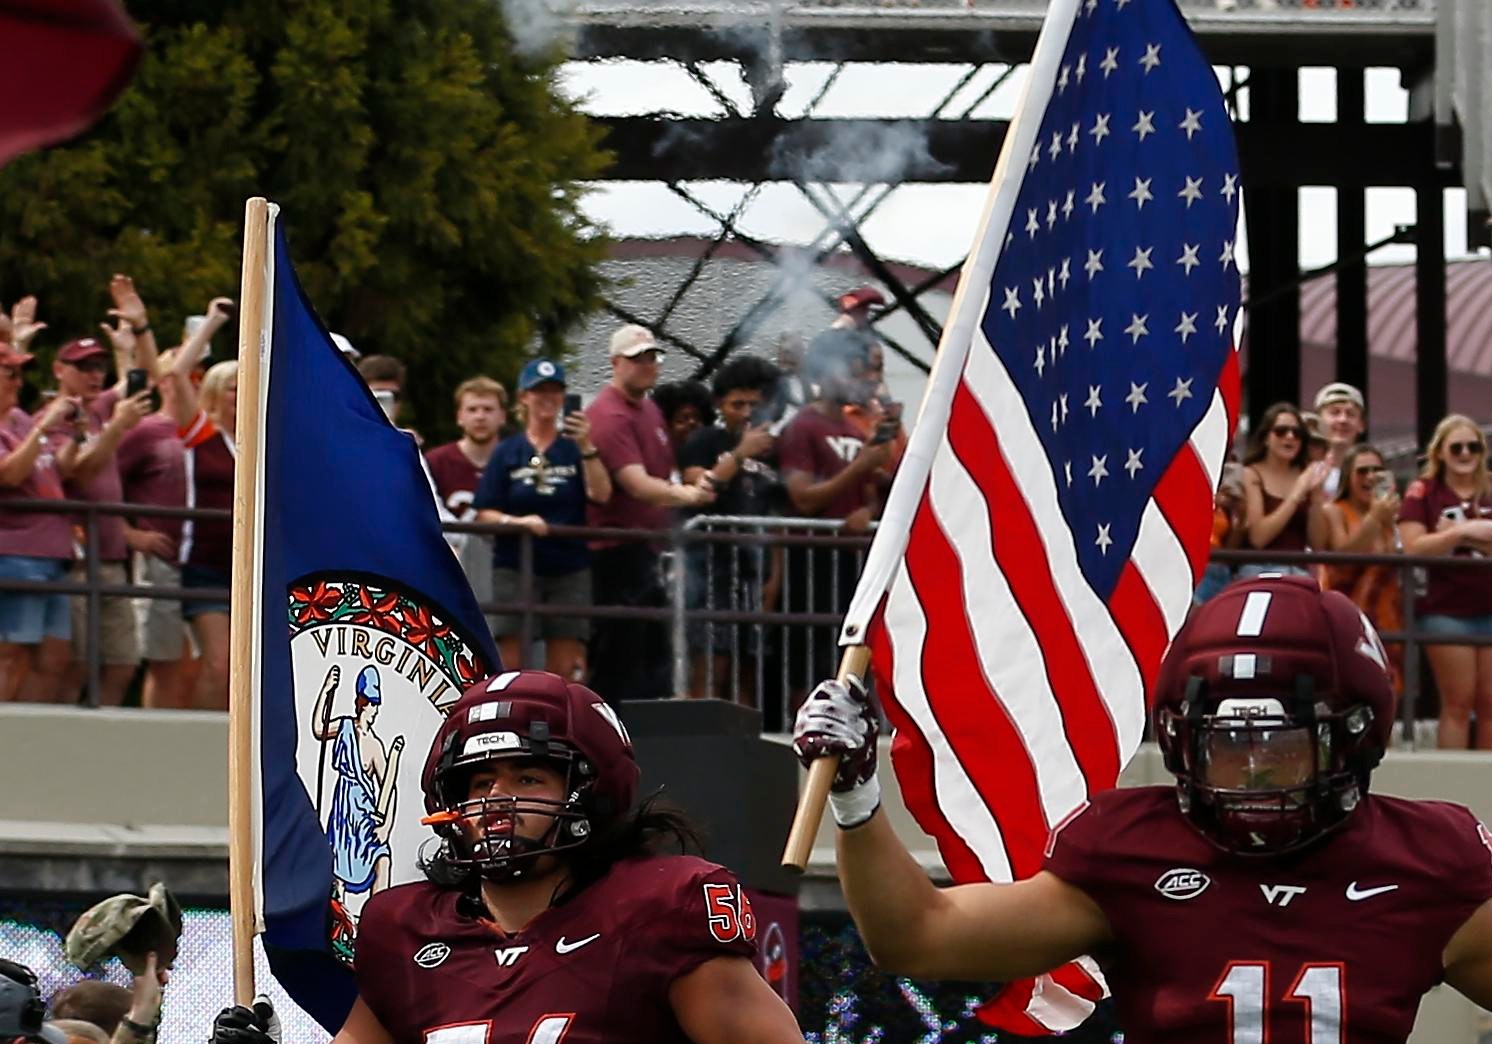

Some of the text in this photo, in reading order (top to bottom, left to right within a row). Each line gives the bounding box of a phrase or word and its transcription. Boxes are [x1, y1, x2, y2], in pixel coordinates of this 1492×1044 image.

[825, 436, 864, 462] VT
[476, 735, 506, 745] TECH
[1260, 884, 1307, 907] VT
[704, 884, 756, 943] 56
[494, 946, 529, 966] VT
